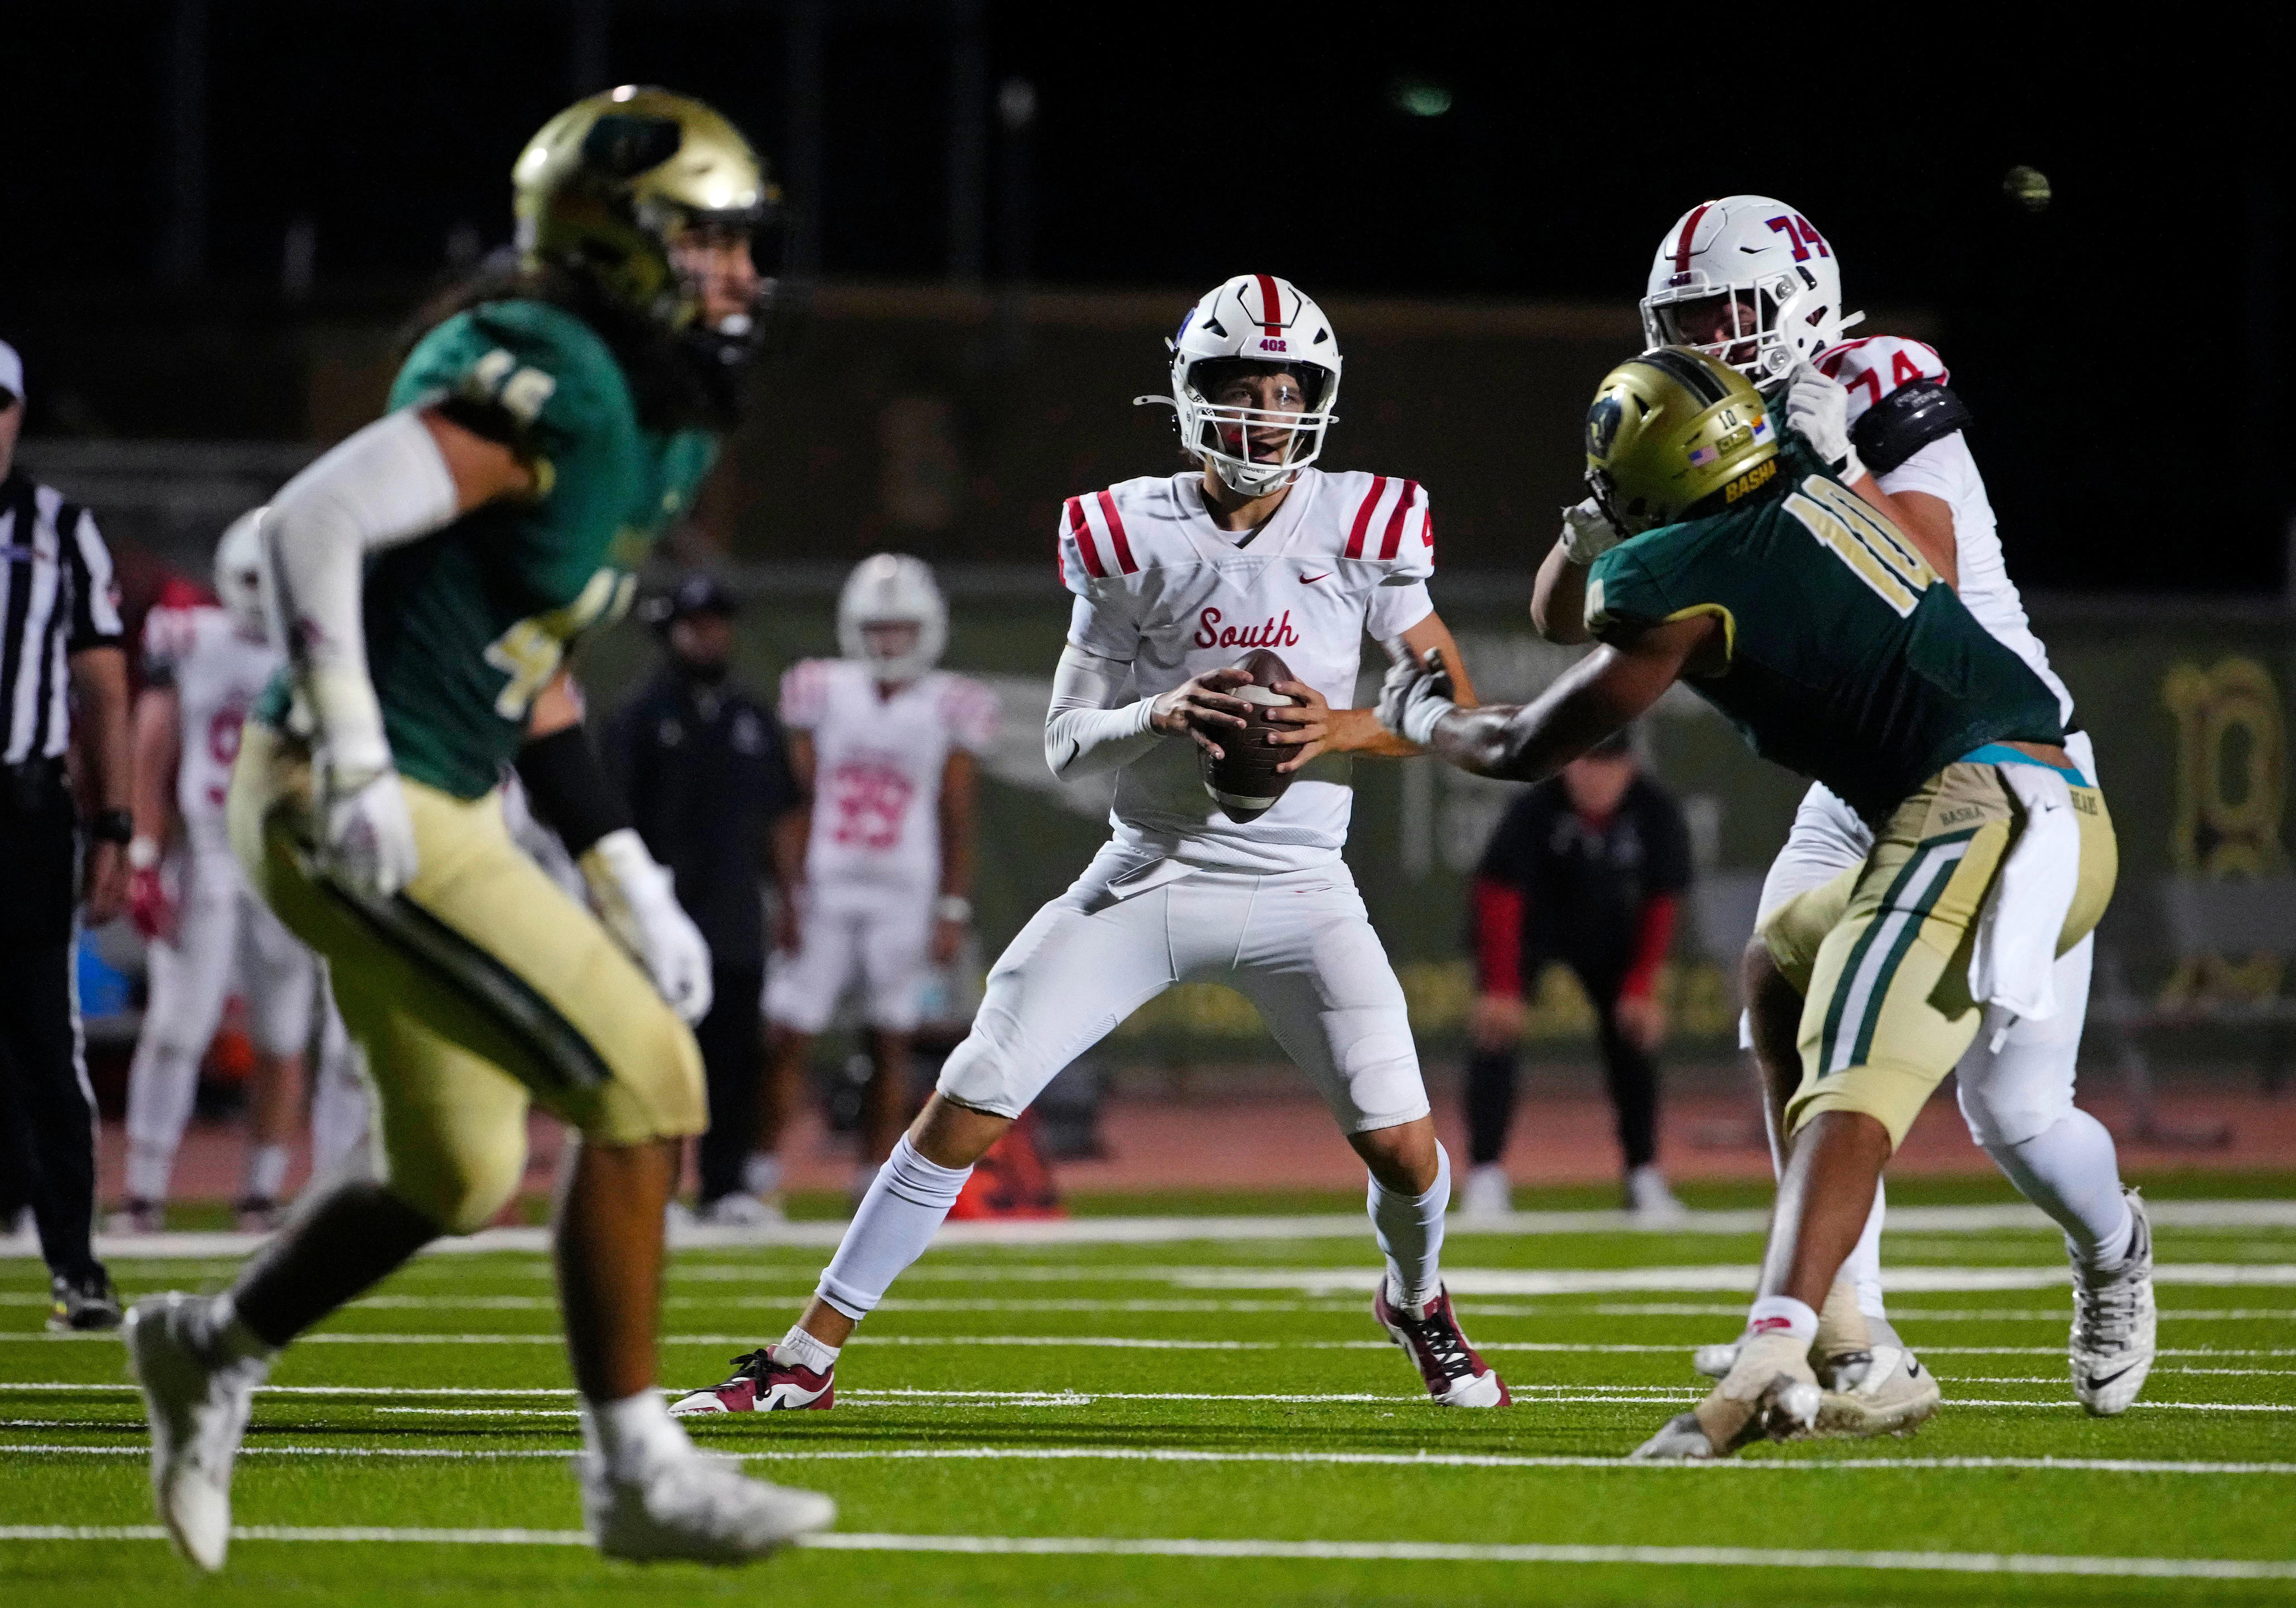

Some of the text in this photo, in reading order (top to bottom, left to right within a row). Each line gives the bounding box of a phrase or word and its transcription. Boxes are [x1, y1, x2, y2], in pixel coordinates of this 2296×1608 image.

[1764, 214, 1829, 263] 74
[1259, 338, 1287, 352] 402
[1845, 349, 1924, 405] 74
[1719, 409, 1738, 430] 10
[1781, 474, 1939, 619] 10
[1194, 607, 1299, 649] South
